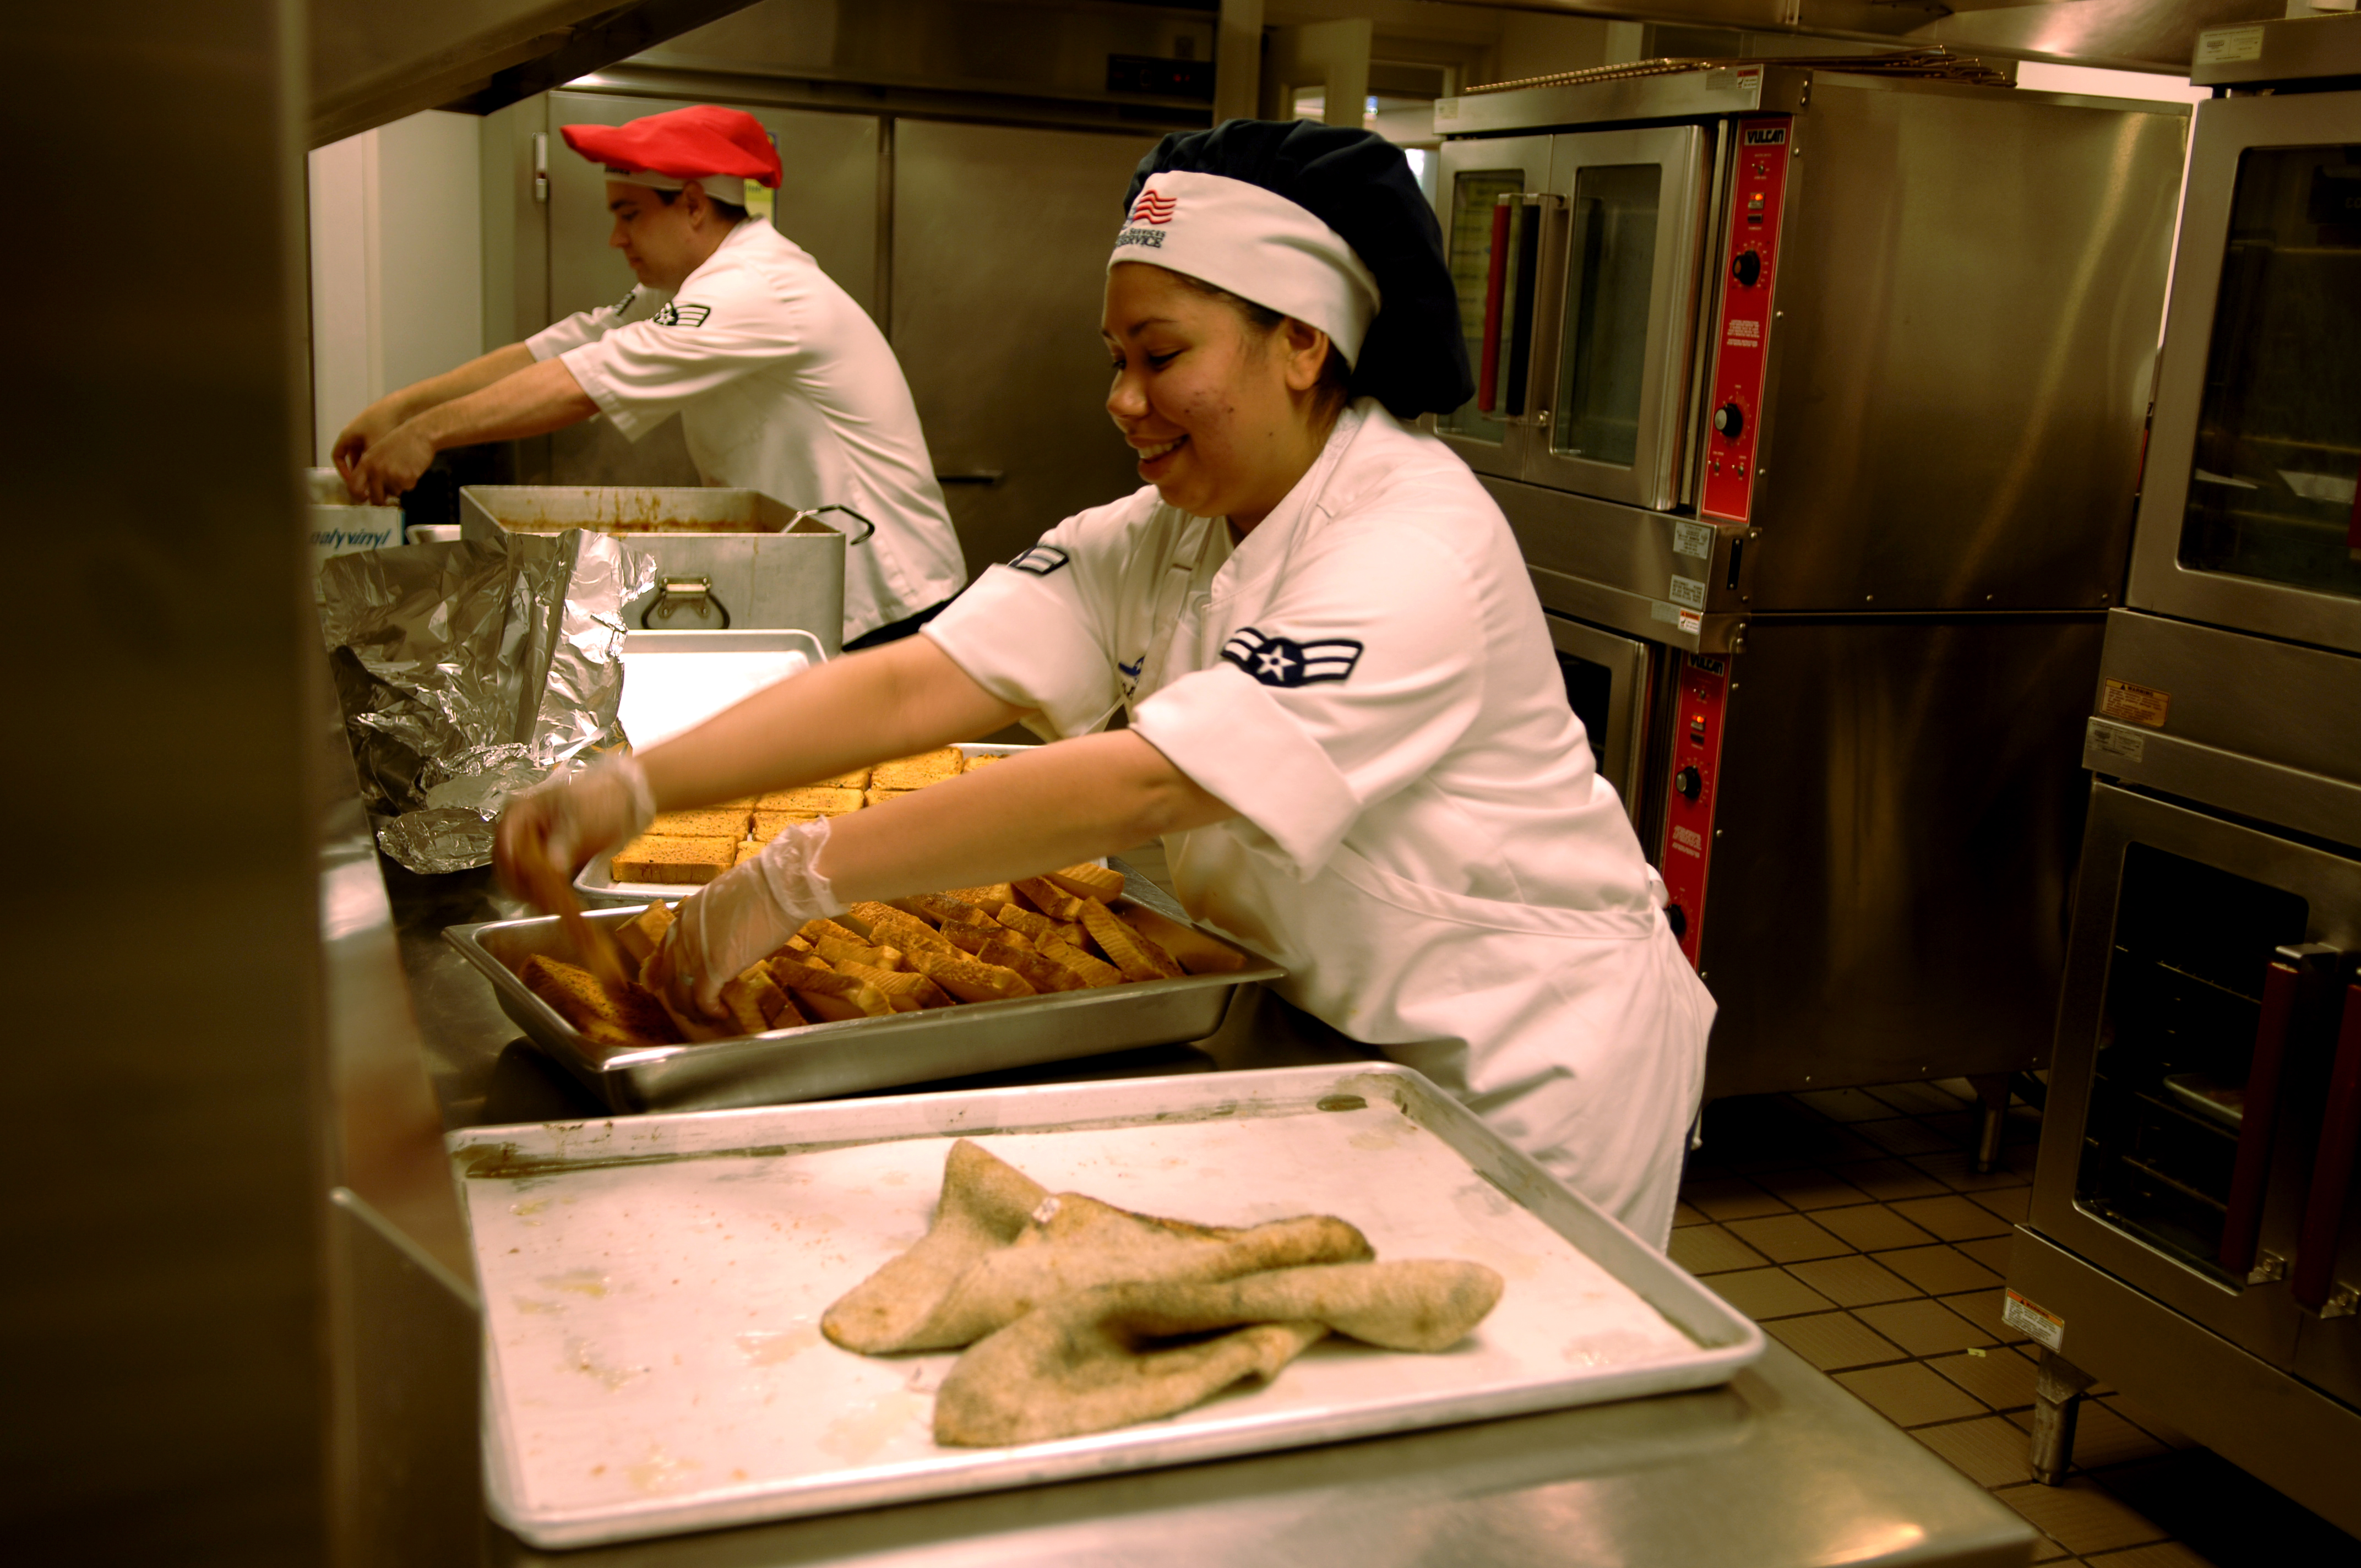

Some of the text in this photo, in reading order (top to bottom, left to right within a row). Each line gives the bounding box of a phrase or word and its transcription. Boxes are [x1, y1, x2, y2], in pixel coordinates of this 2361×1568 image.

[1747, 129, 1784, 143] VULCAN
[1690, 654, 1723, 675] VULCAN
[2127, 685, 2153, 697] WARNING
